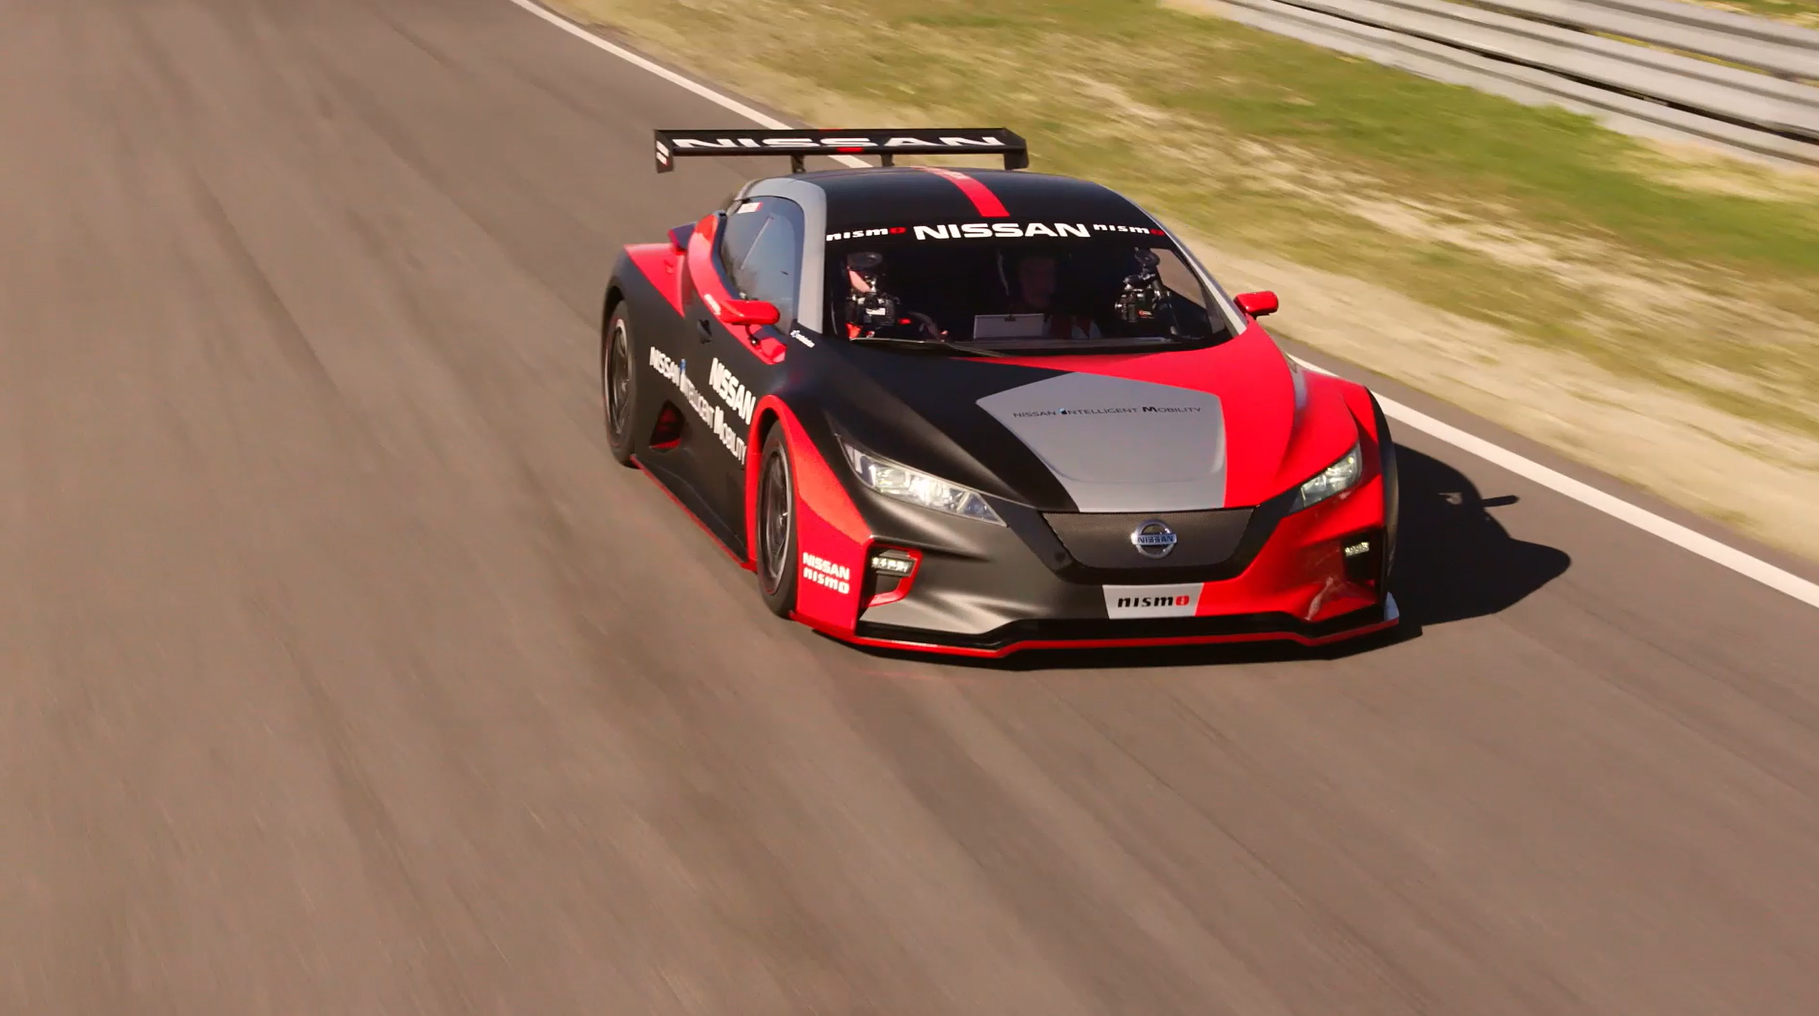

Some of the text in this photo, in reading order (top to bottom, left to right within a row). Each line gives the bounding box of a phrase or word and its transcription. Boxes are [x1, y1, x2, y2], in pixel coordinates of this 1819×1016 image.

[672, 137, 1005, 148] NISSAN
[912, 222, 1092, 241] NISSAN
[649, 346, 681, 387] NISSAN
[708, 357, 757, 425] NISSAN
[1012, 410, 1056, 418] NISSAN
[1137, 535, 1175, 544] NISSAN
[802, 551, 850, 580] NISSAN
[1117, 595, 1190, 608] nismo
